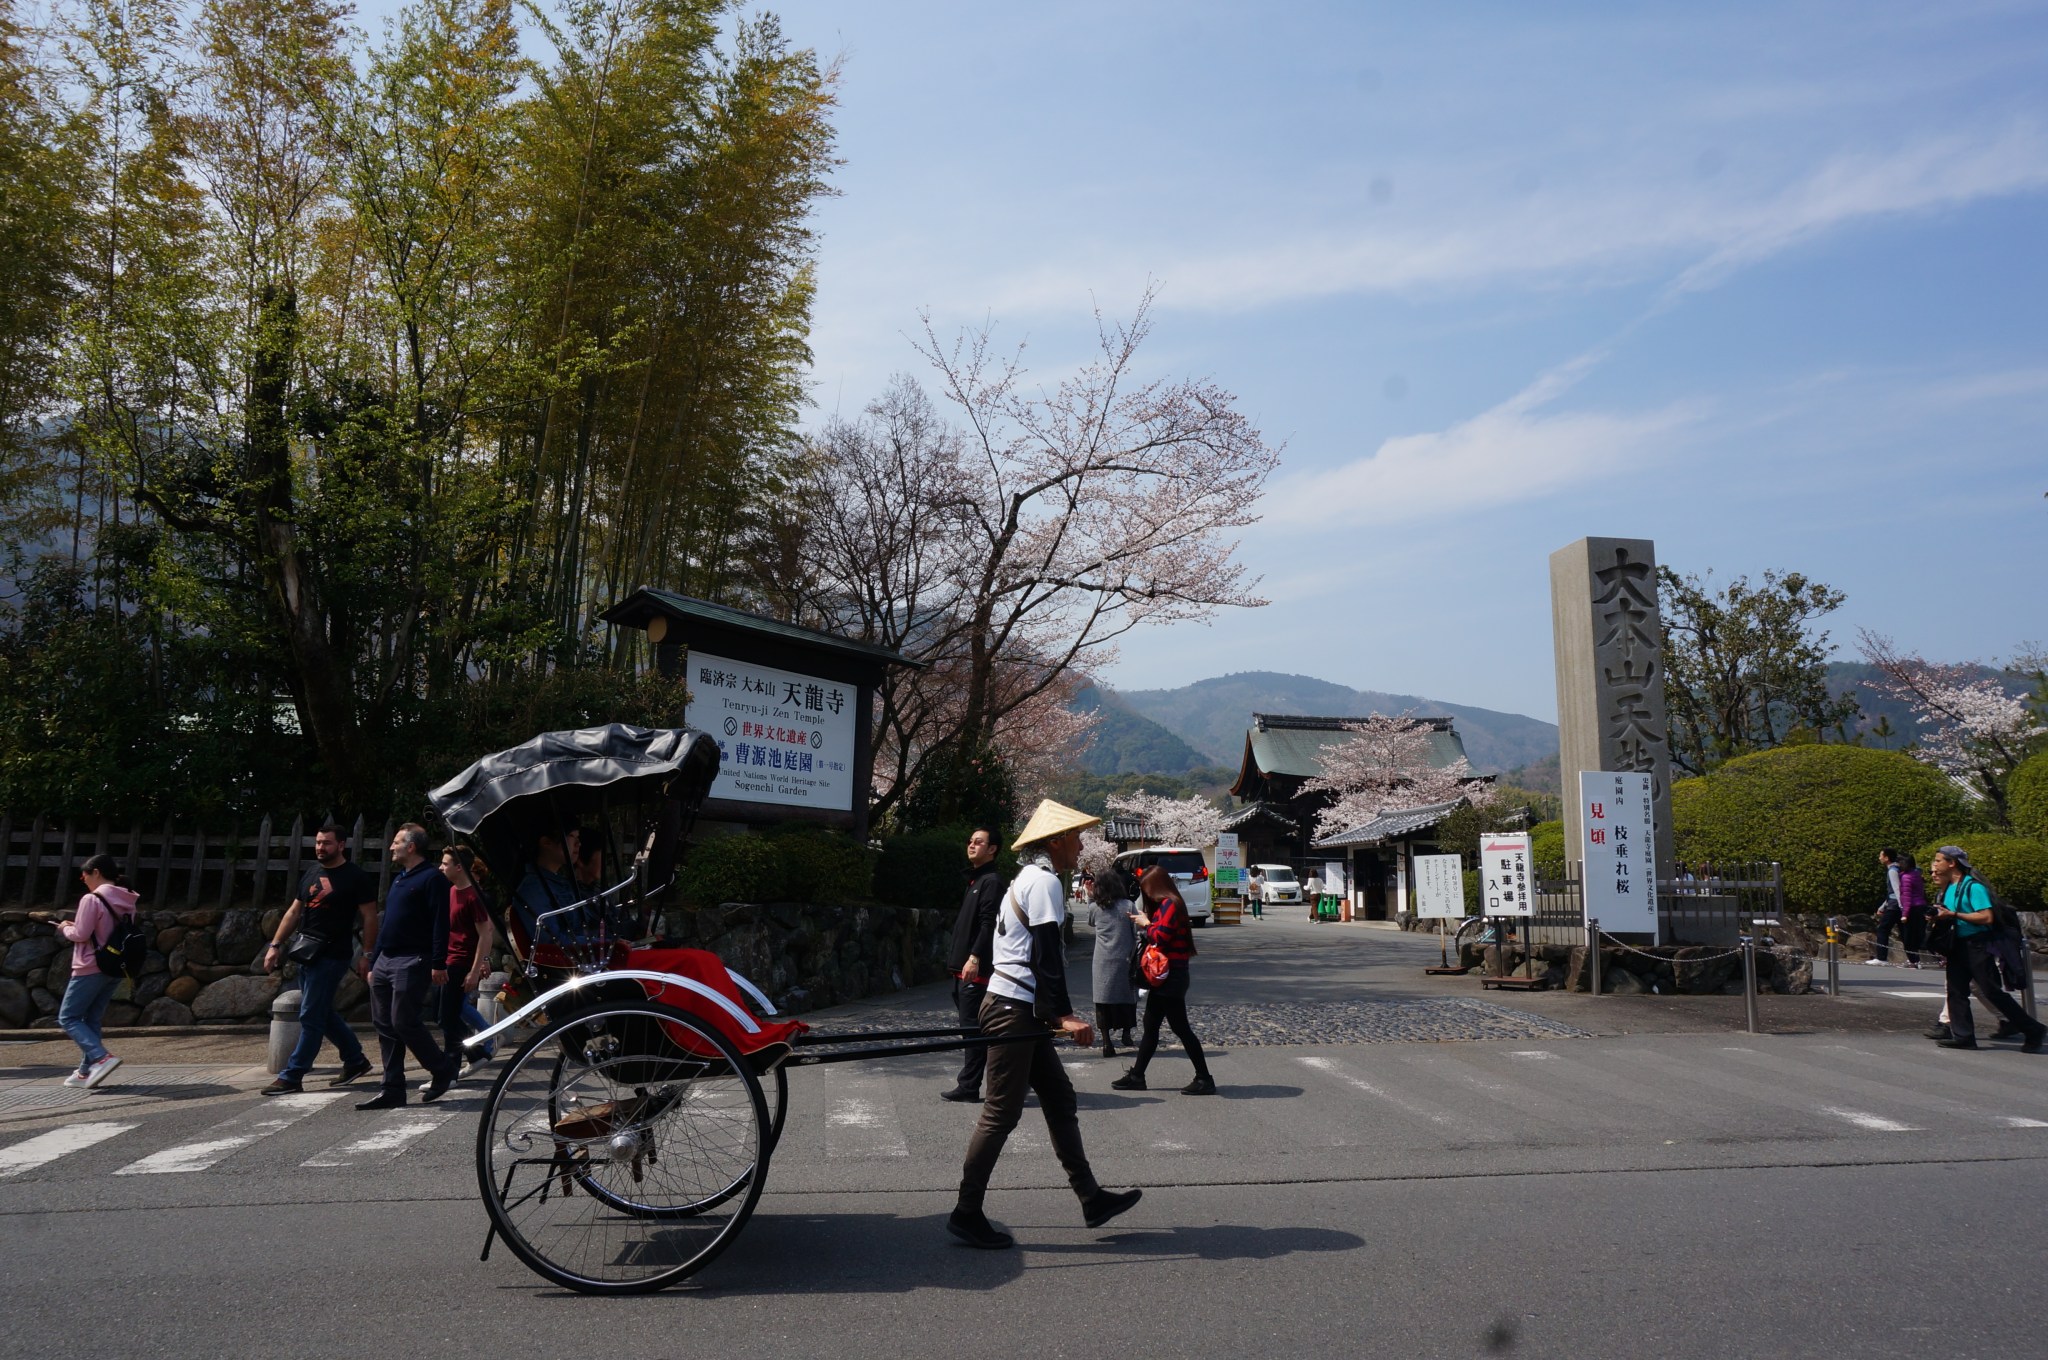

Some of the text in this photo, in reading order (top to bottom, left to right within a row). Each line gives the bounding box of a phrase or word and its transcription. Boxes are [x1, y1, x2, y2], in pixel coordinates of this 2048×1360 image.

[700, 668, 845, 715] 臨済宗 大本山 天龍寺
[722, 697, 825, 725] Tenryu-ji Zen Temple
[742, 721, 808, 745] 世界文化遺産
[735, 742, 813, 773] 曹源池庭園
[718, 767, 831, 788] United Nations World Heritage Site
[735, 780, 808, 797] Sogenchi Garden
[1590, 803, 1606, 845] 見頃
[1614, 776, 1630, 894] 庭園内 枝垂れ桜
[1489, 879, 1499, 908] 入口
[1501, 859, 1514, 902] 駐車場
